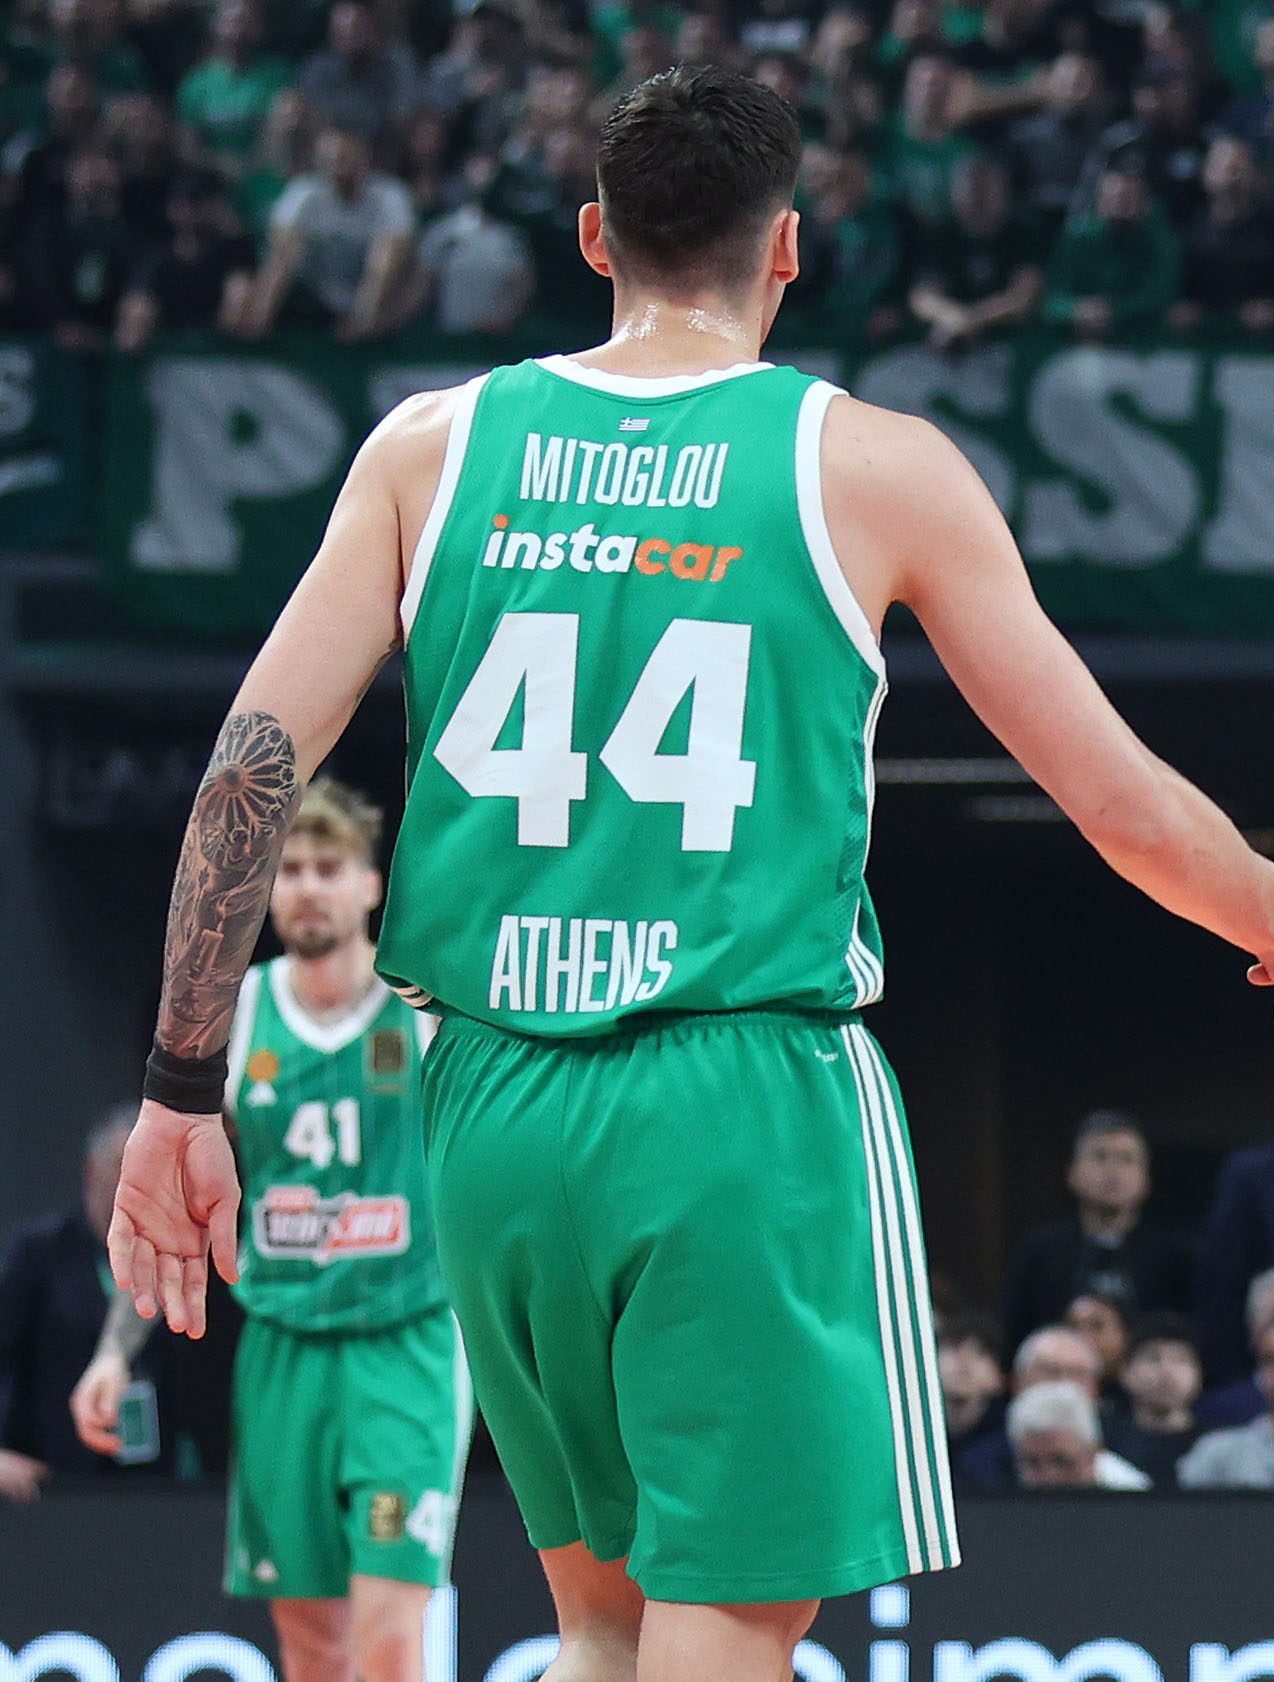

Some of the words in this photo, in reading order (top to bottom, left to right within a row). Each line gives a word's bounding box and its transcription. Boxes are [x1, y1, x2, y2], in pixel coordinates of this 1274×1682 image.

[519, 431, 730, 510] MITOGLOU
[482, 513, 744, 583] instacar
[432, 611, 757, 853] 44
[488, 914, 679, 1013] ATHENS
[283, 1097, 362, 1168] 41
